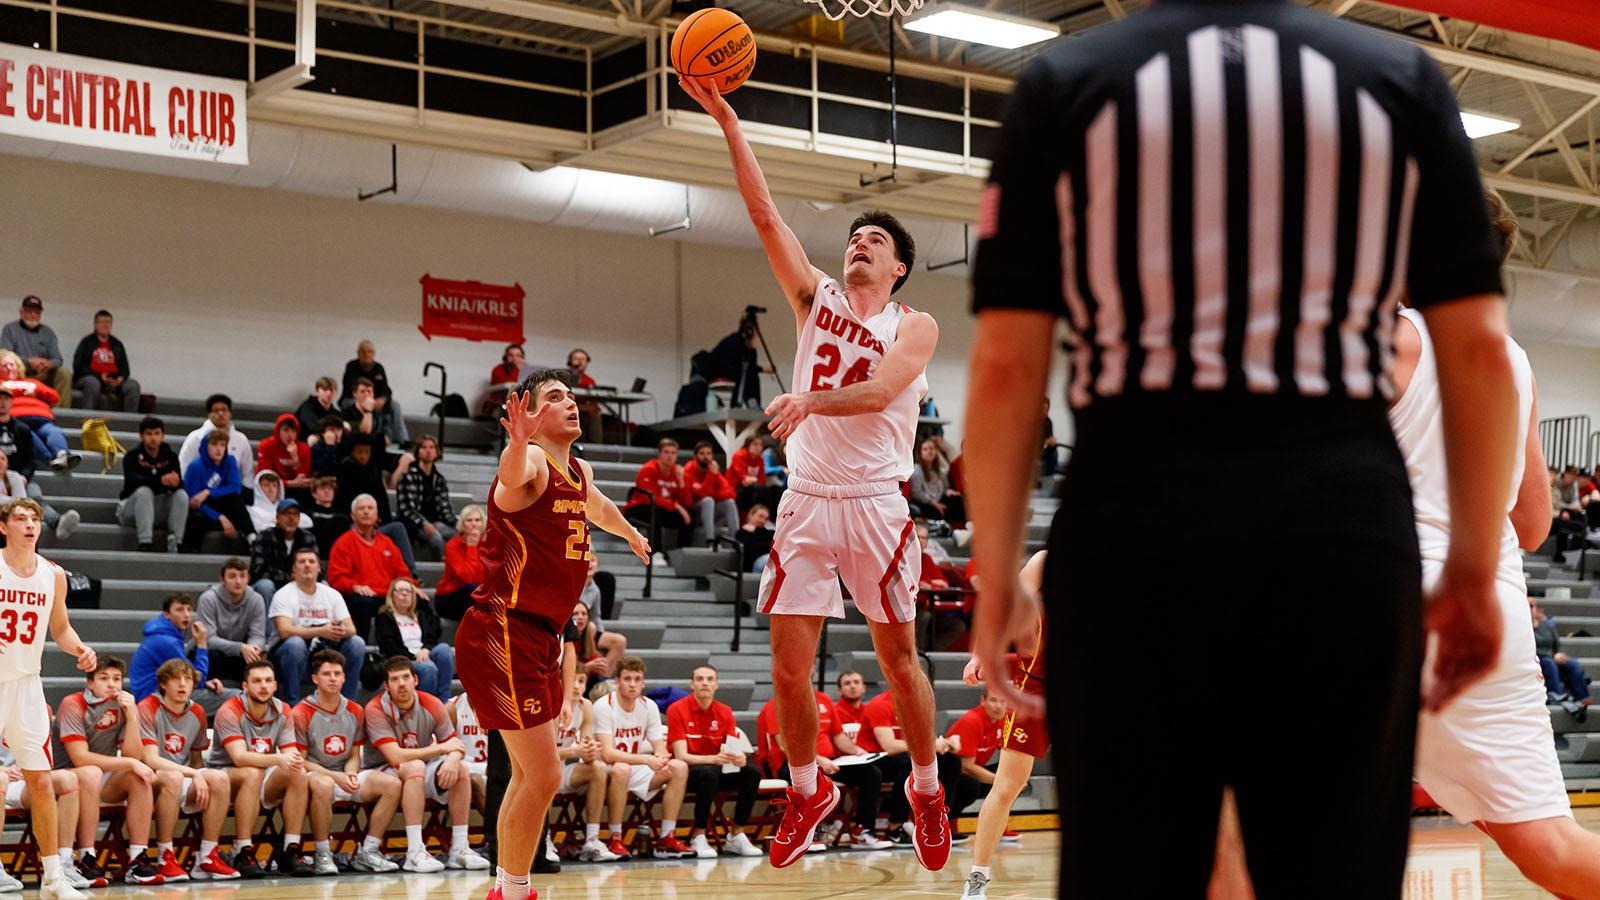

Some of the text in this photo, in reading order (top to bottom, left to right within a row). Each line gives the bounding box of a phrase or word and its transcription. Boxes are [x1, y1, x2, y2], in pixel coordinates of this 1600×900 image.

[705, 33, 752, 67] Wilson
[26, 64, 156, 137] CENTRAL
[168, 86, 235, 147] CLUB
[427, 294, 519, 317] KNIA/KRLS
[810, 342, 872, 392] 24
[0, 609, 38, 645] 33
